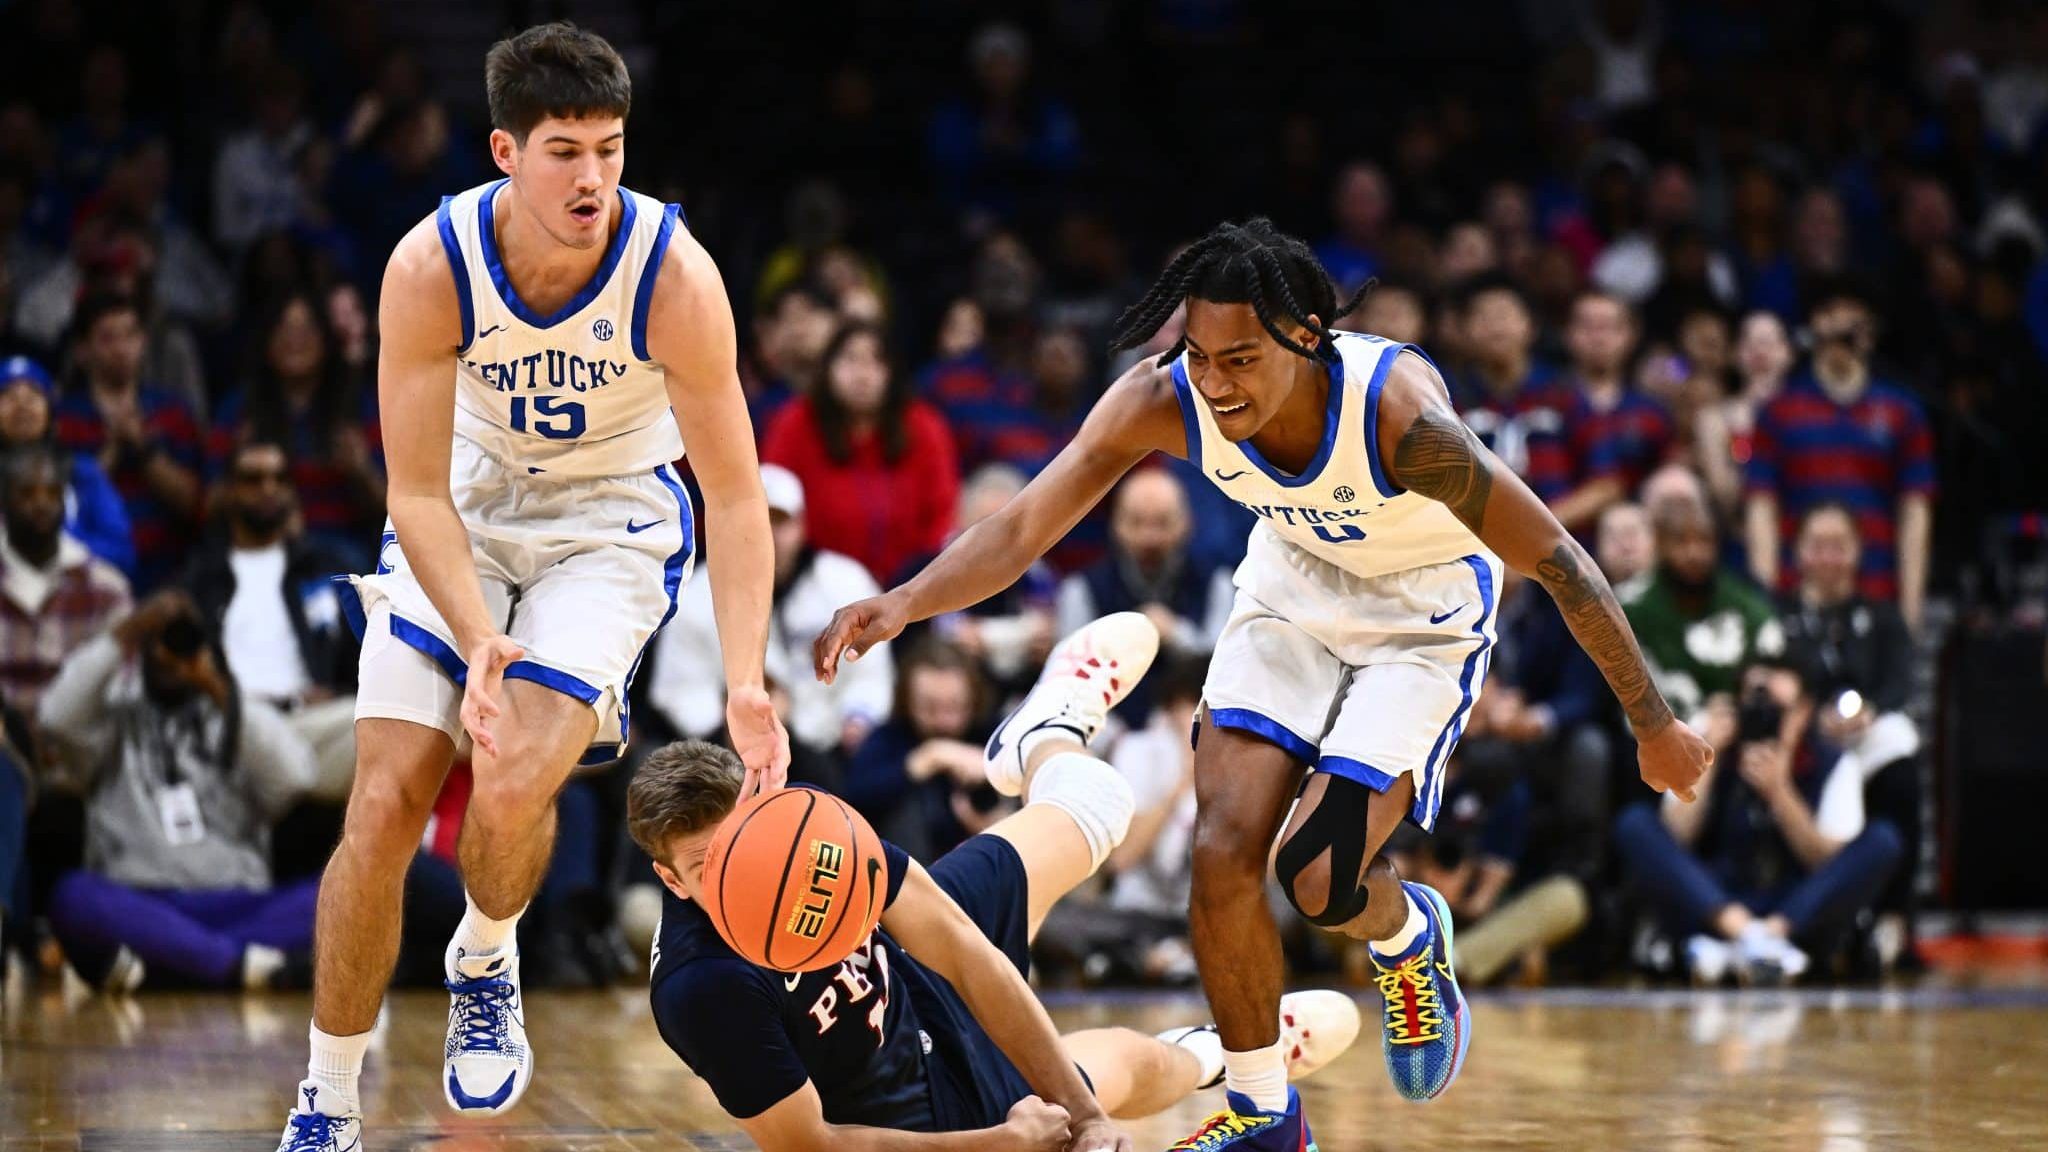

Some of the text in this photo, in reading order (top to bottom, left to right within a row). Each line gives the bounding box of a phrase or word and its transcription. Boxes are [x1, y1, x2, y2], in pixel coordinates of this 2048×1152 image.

[593, 319, 614, 341] SEC
[459, 349, 627, 392] ENTUCKY
[510, 396, 587, 439] 15
[1333, 485, 1355, 503] SEC
[792, 840, 844, 940] ELITE
